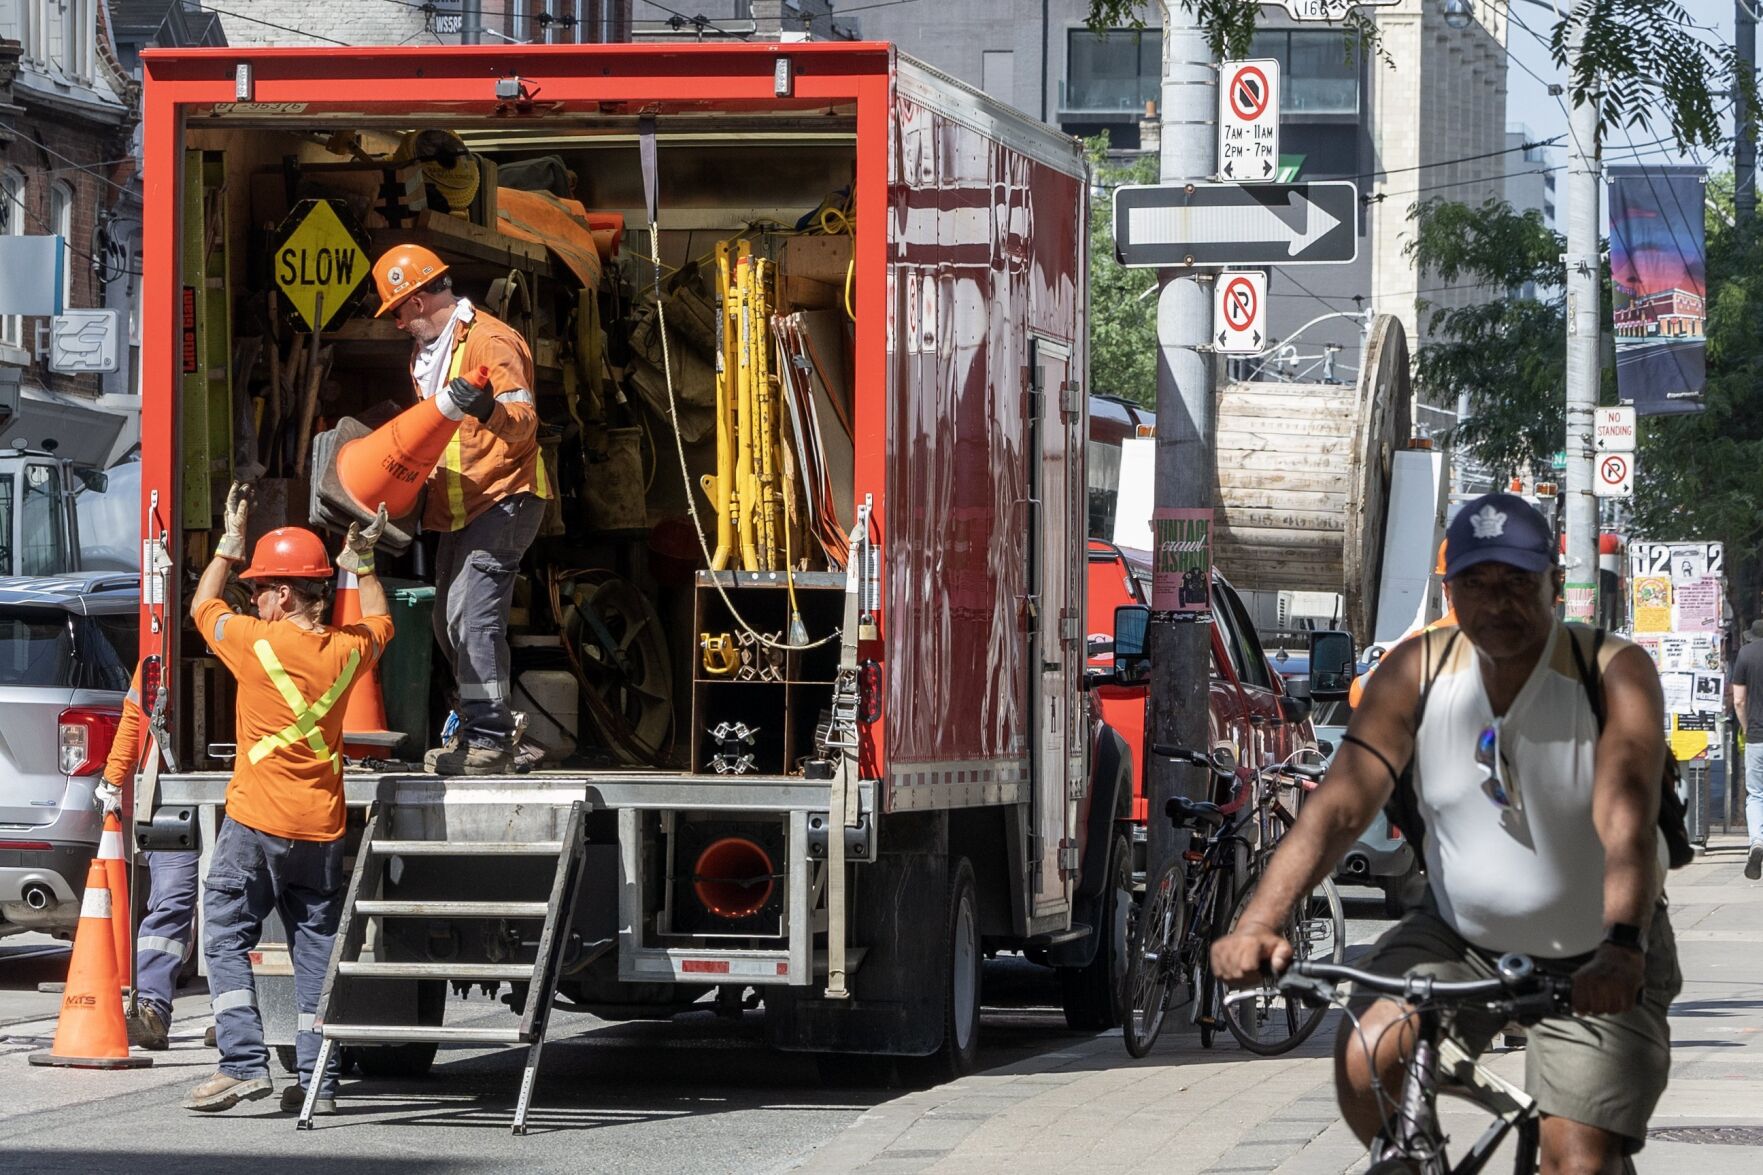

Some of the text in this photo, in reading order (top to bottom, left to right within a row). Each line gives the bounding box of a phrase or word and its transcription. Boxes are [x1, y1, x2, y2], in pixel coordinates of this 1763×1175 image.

[1224, 124, 1242, 140] 7AM
[1254, 124, 1273, 139] 11AM
[1224, 142, 1242, 157] 2PM
[1254, 142, 1273, 157] 7PM
[280, 248, 355, 286] SLOW
[1608, 412, 1621, 423] NO
[1597, 425, 1632, 437] STANDING
[1161, 534, 1208, 553] crawl
